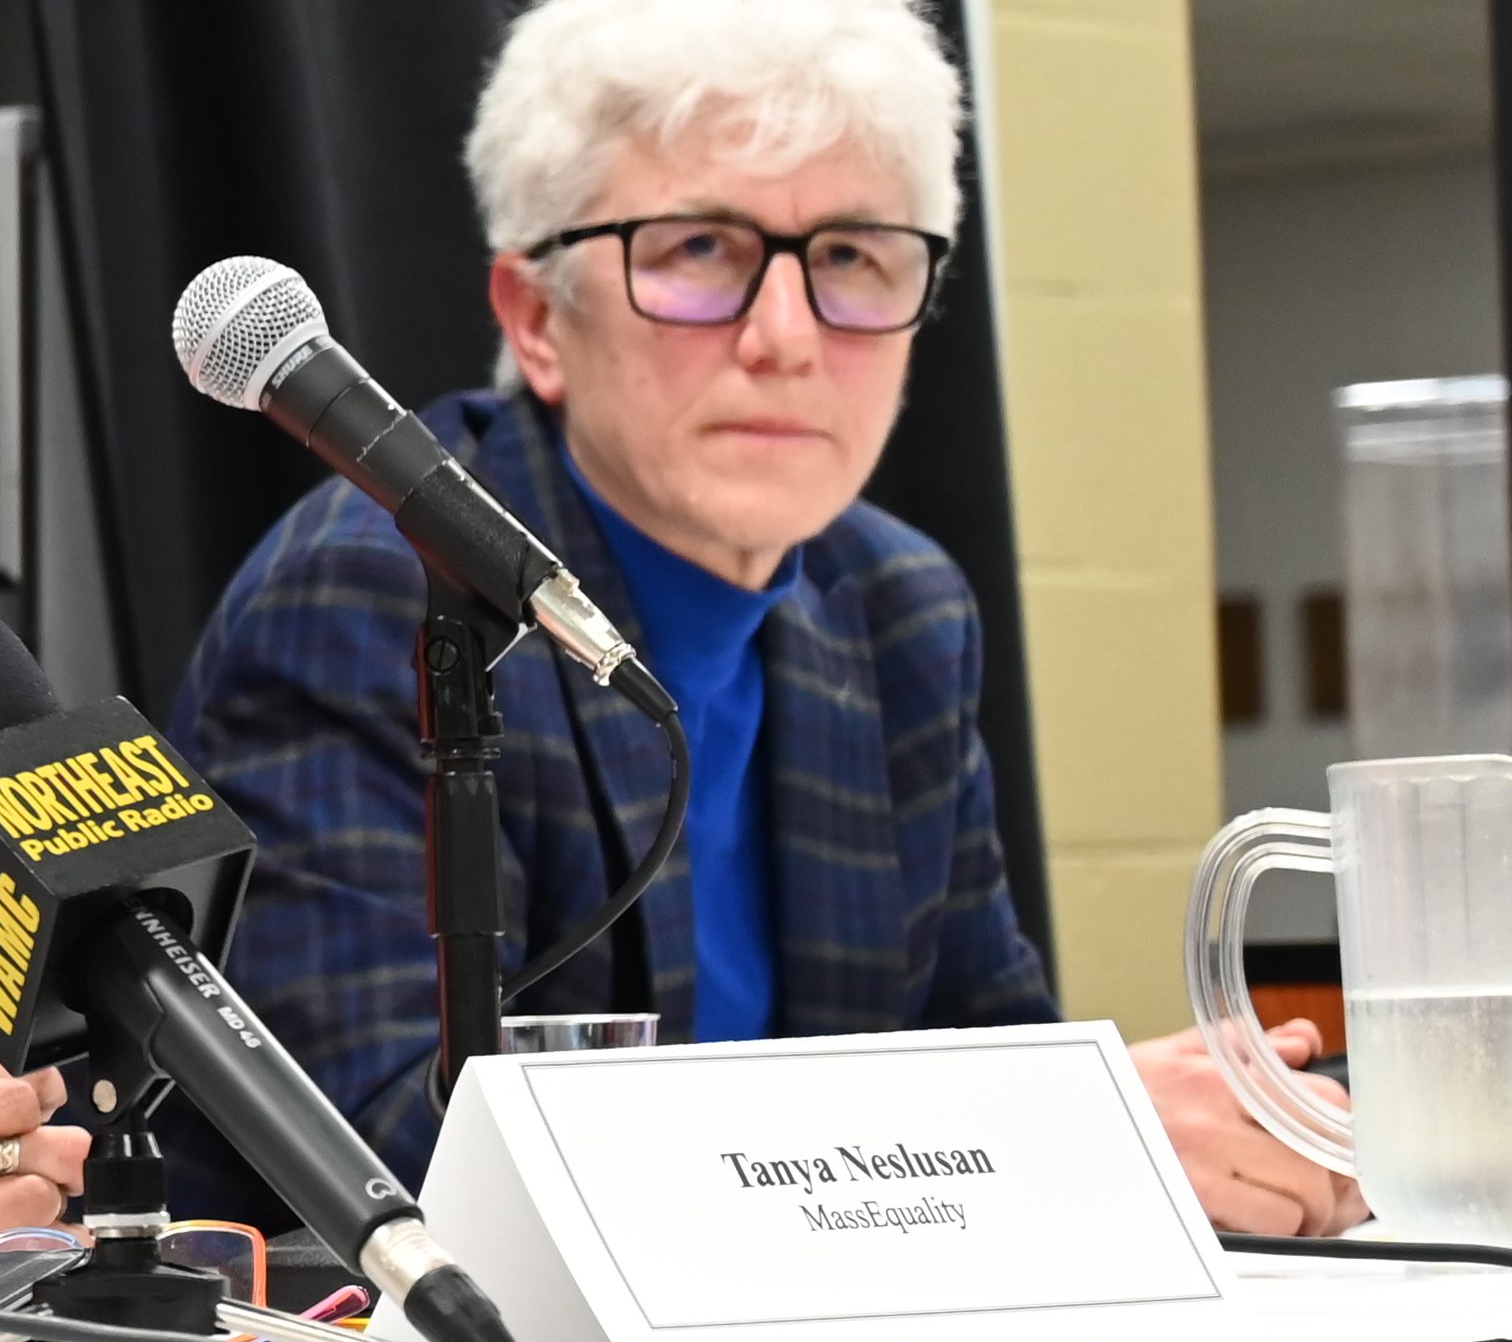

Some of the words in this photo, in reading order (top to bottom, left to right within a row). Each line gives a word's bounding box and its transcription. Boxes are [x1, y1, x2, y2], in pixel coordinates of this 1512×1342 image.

[20, 818, 126, 863] Public
[122, 791, 216, 834] Radio
[122, 895, 222, 1000] ENNHEISER
[216, 1005, 246, 1032] MD
[238, 1027, 262, 1050] 46
[720, 1152, 838, 1196] Tanya
[834, 1143, 997, 1182] Neslusan
[798, 1196, 967, 1235] MassEquality
